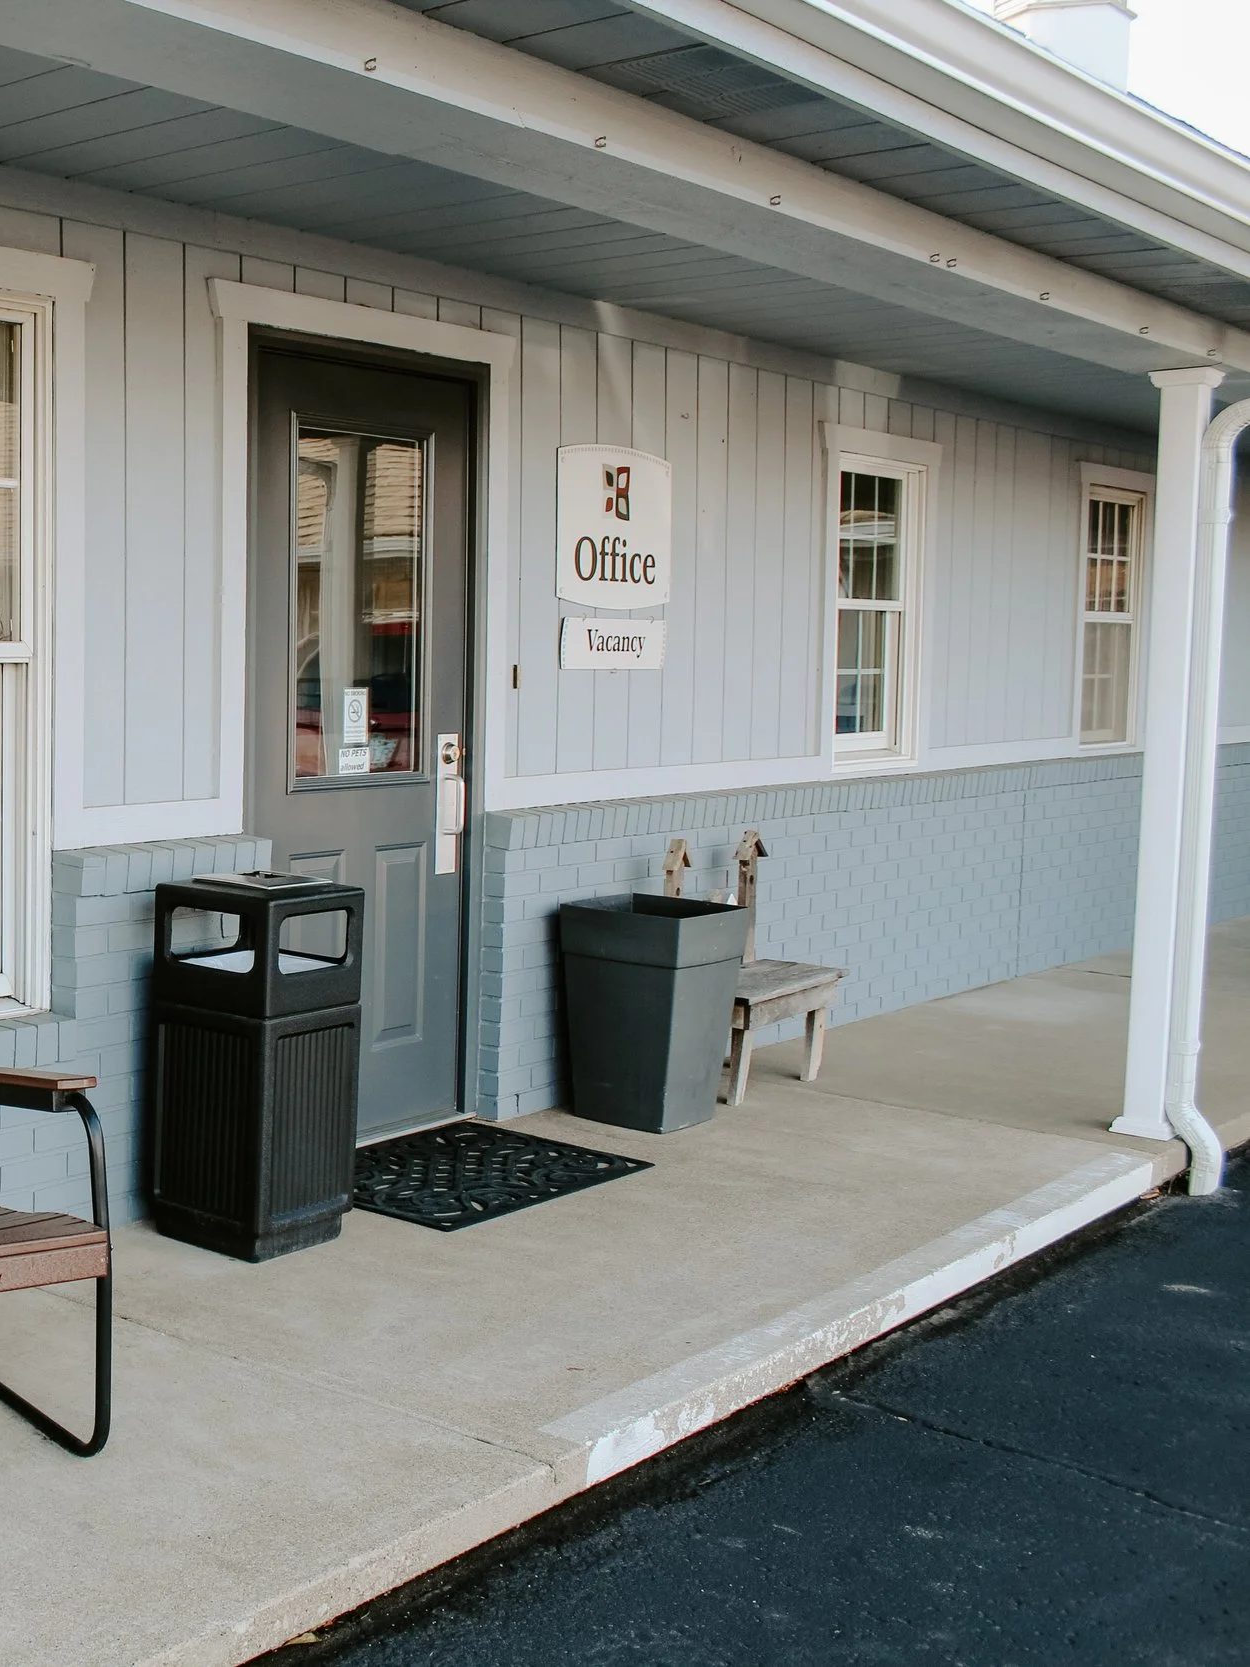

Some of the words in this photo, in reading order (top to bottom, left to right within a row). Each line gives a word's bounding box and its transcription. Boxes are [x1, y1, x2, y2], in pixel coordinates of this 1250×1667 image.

[574, 536, 656, 584] Office
[586, 628, 646, 659] Vacancy
[351, 748, 367, 757] PETS
[341, 762, 365, 772] allowed
